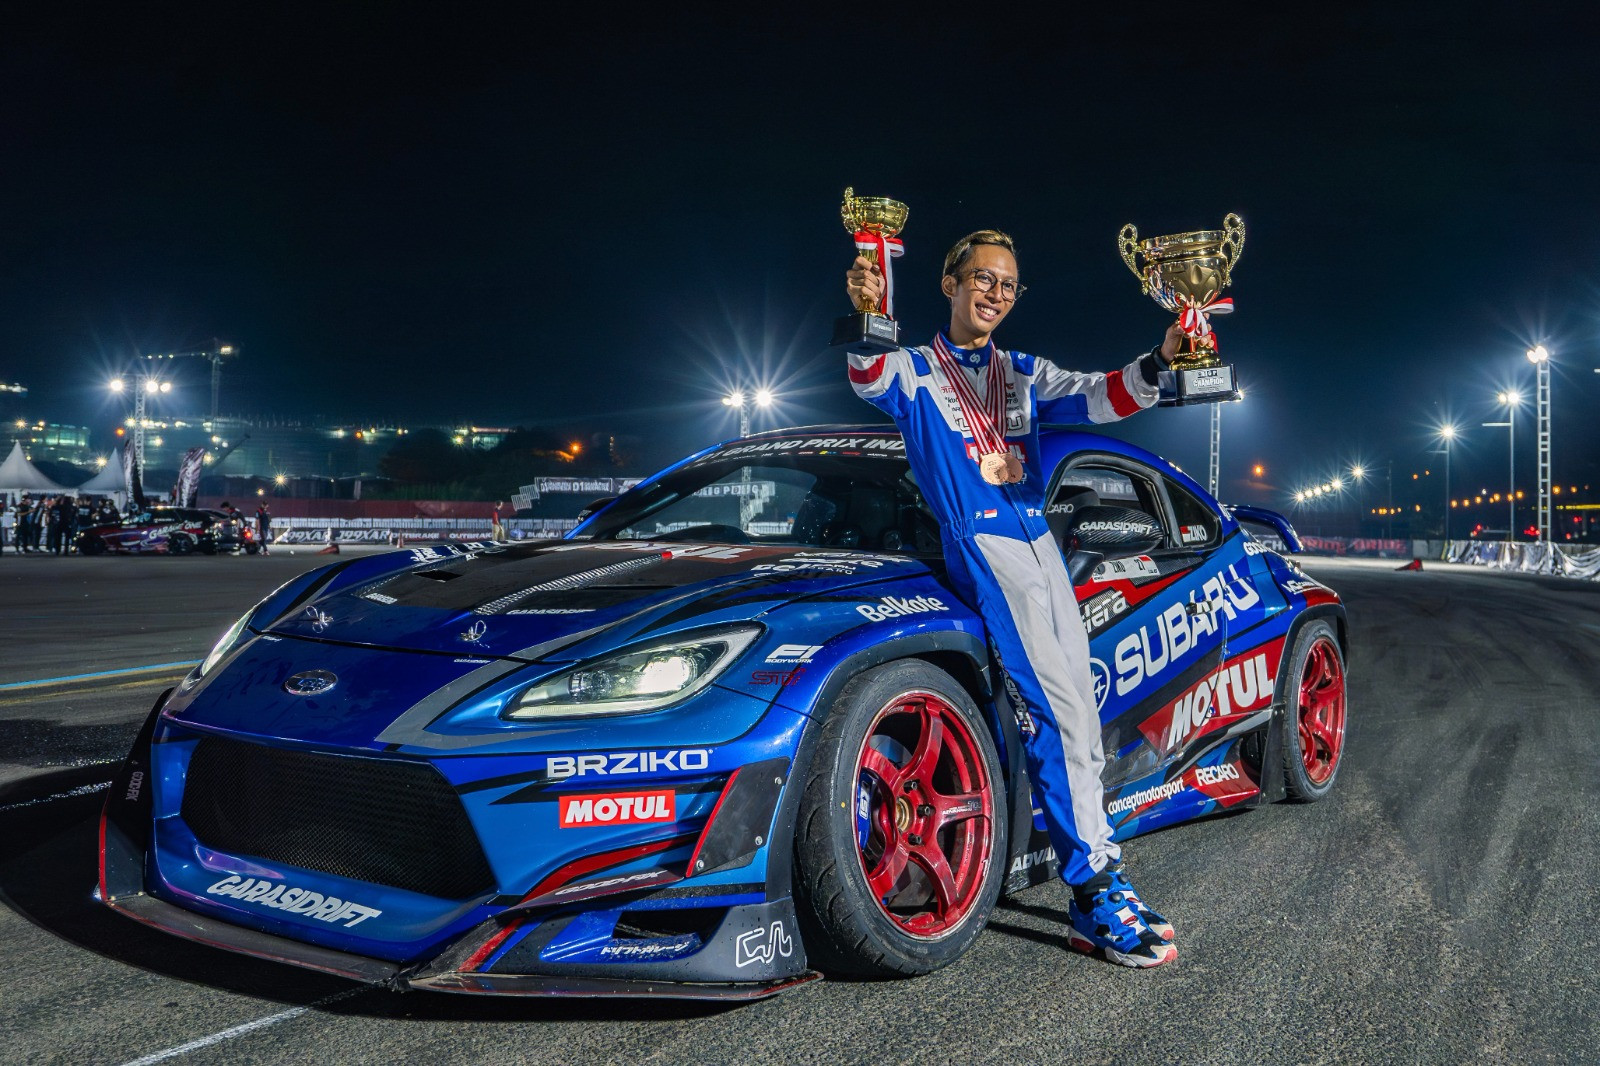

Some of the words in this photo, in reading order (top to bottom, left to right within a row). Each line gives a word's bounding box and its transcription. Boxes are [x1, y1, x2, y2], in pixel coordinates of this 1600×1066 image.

[722, 440, 803, 457] GRAND
[799, 438, 866, 449] PRIX
[449, 532, 493, 540] OUTBRAK
[1080, 521, 1152, 535] GARASIDRIFT
[1188, 524, 1208, 541] ZIKO
[856, 595, 950, 623] Belkote
[1114, 564, 1260, 697] SUBARU
[1167, 653, 1274, 750] MOTUL
[547, 749, 708, 778] BRZIKO
[1195, 763, 1240, 787] RECARO
[565, 795, 670, 824] MOTUL
[1107, 777, 1185, 815] conceptmotorsport
[206, 875, 383, 928] GARASIDRIFT
